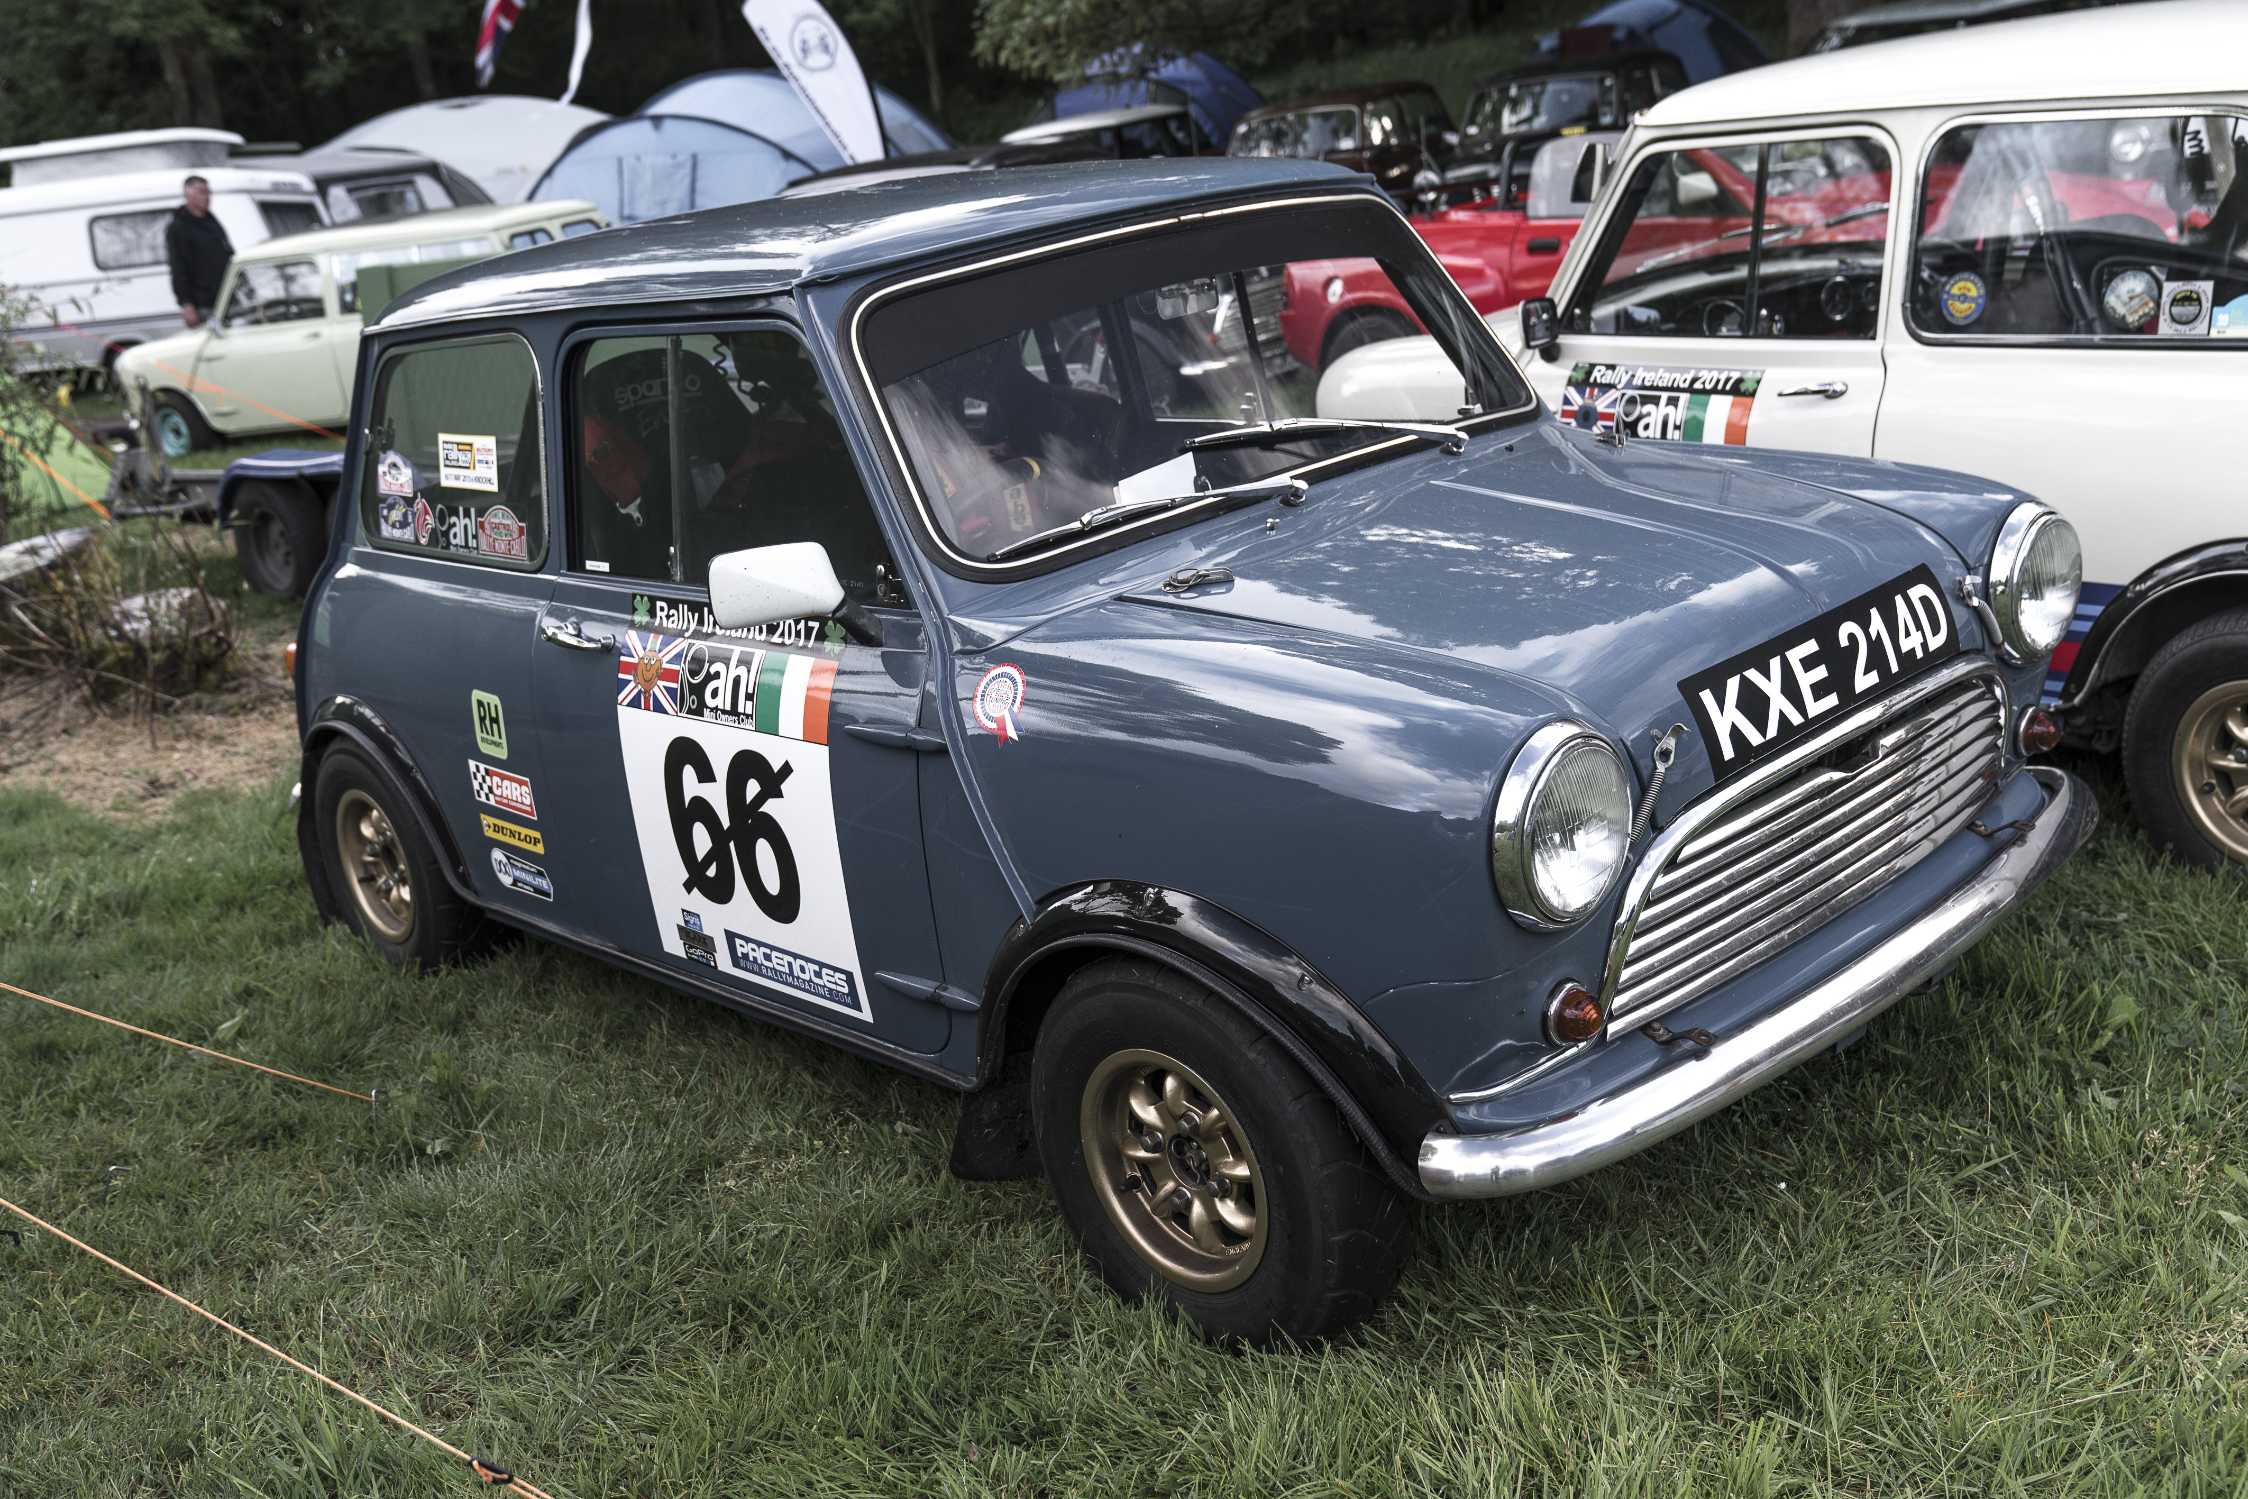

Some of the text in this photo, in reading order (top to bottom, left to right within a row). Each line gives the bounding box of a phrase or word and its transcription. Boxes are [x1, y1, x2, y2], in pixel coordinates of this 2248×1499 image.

[615, 374, 700, 408] sparo
[1589, 365, 1741, 391] Rally Ireland 2017
[449, 505, 477, 548] ah!
[654, 600, 699, 637] Rally
[770, 619, 820, 649] 2017
[704, 649, 759, 714] ah!
[1699, 583, 1948, 762] KXE 214D
[476, 698, 503, 740] RH
[703, 707, 754, 728] Mini Owners Club
[492, 775, 532, 805] CARS
[492, 823, 541, 846] DUNLOP
[664, 735, 801, 925] 66
[734, 937, 849, 994] PACENOTES
